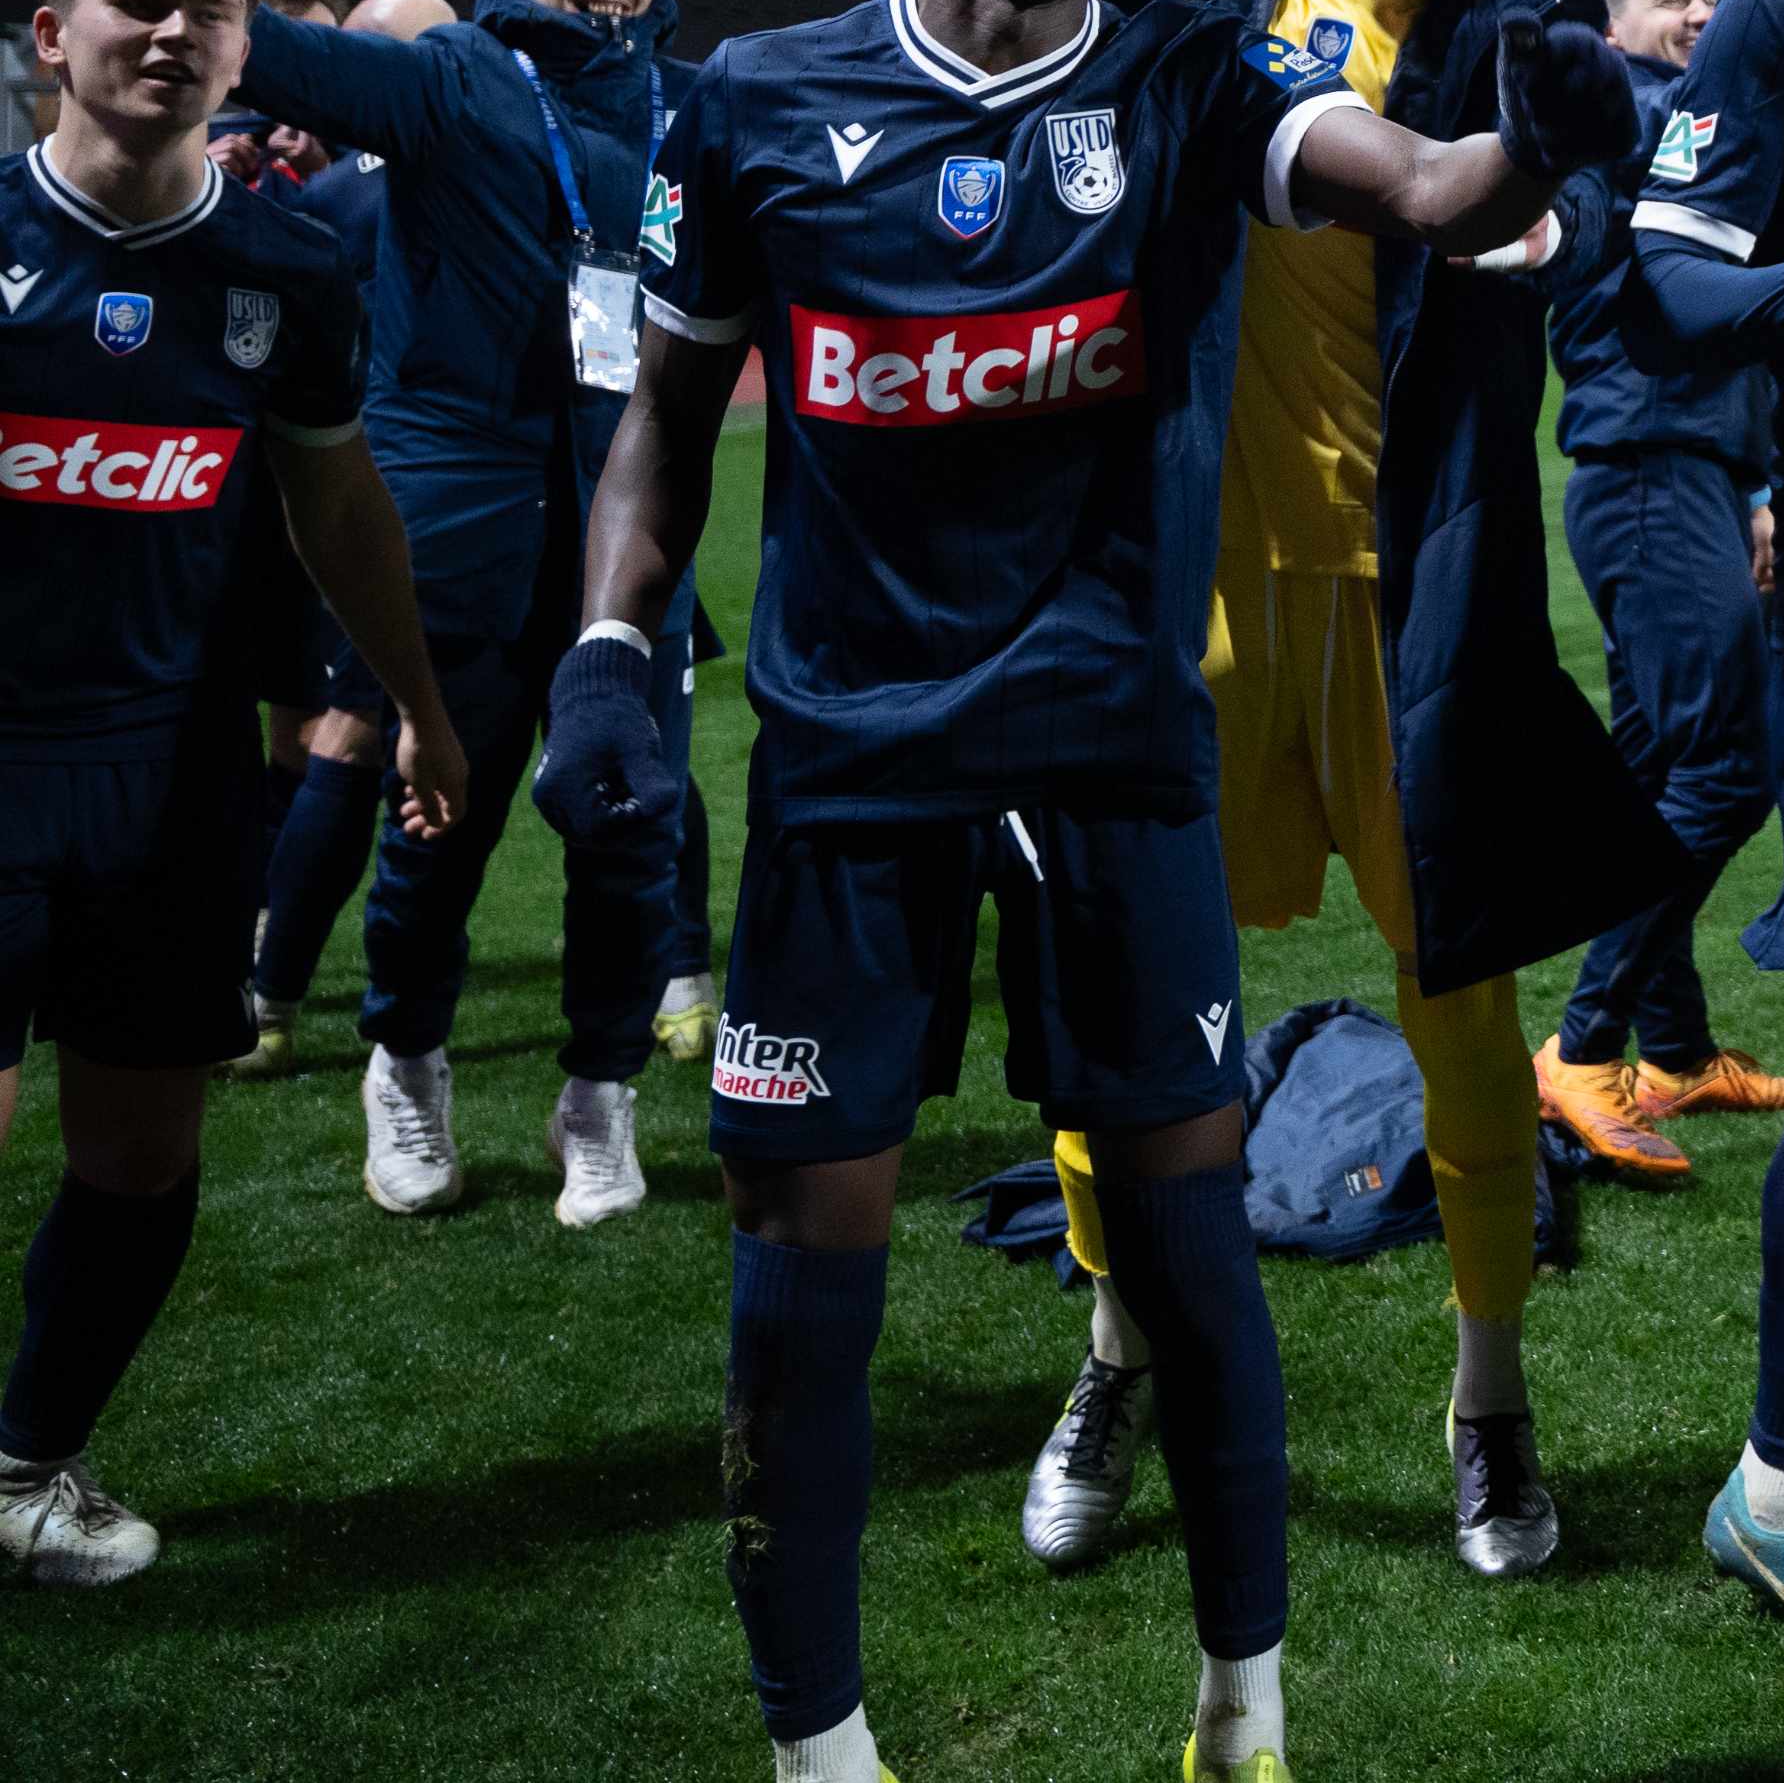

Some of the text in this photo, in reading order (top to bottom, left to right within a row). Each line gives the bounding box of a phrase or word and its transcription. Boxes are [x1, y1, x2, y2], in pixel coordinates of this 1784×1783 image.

[1053, 118, 1109, 158] USLD
[954, 210, 986, 221] FFF
[107, 334, 136, 344] FFF
[808, 314, 1128, 413] Betclic
[0, 432, 223, 501] etclic
